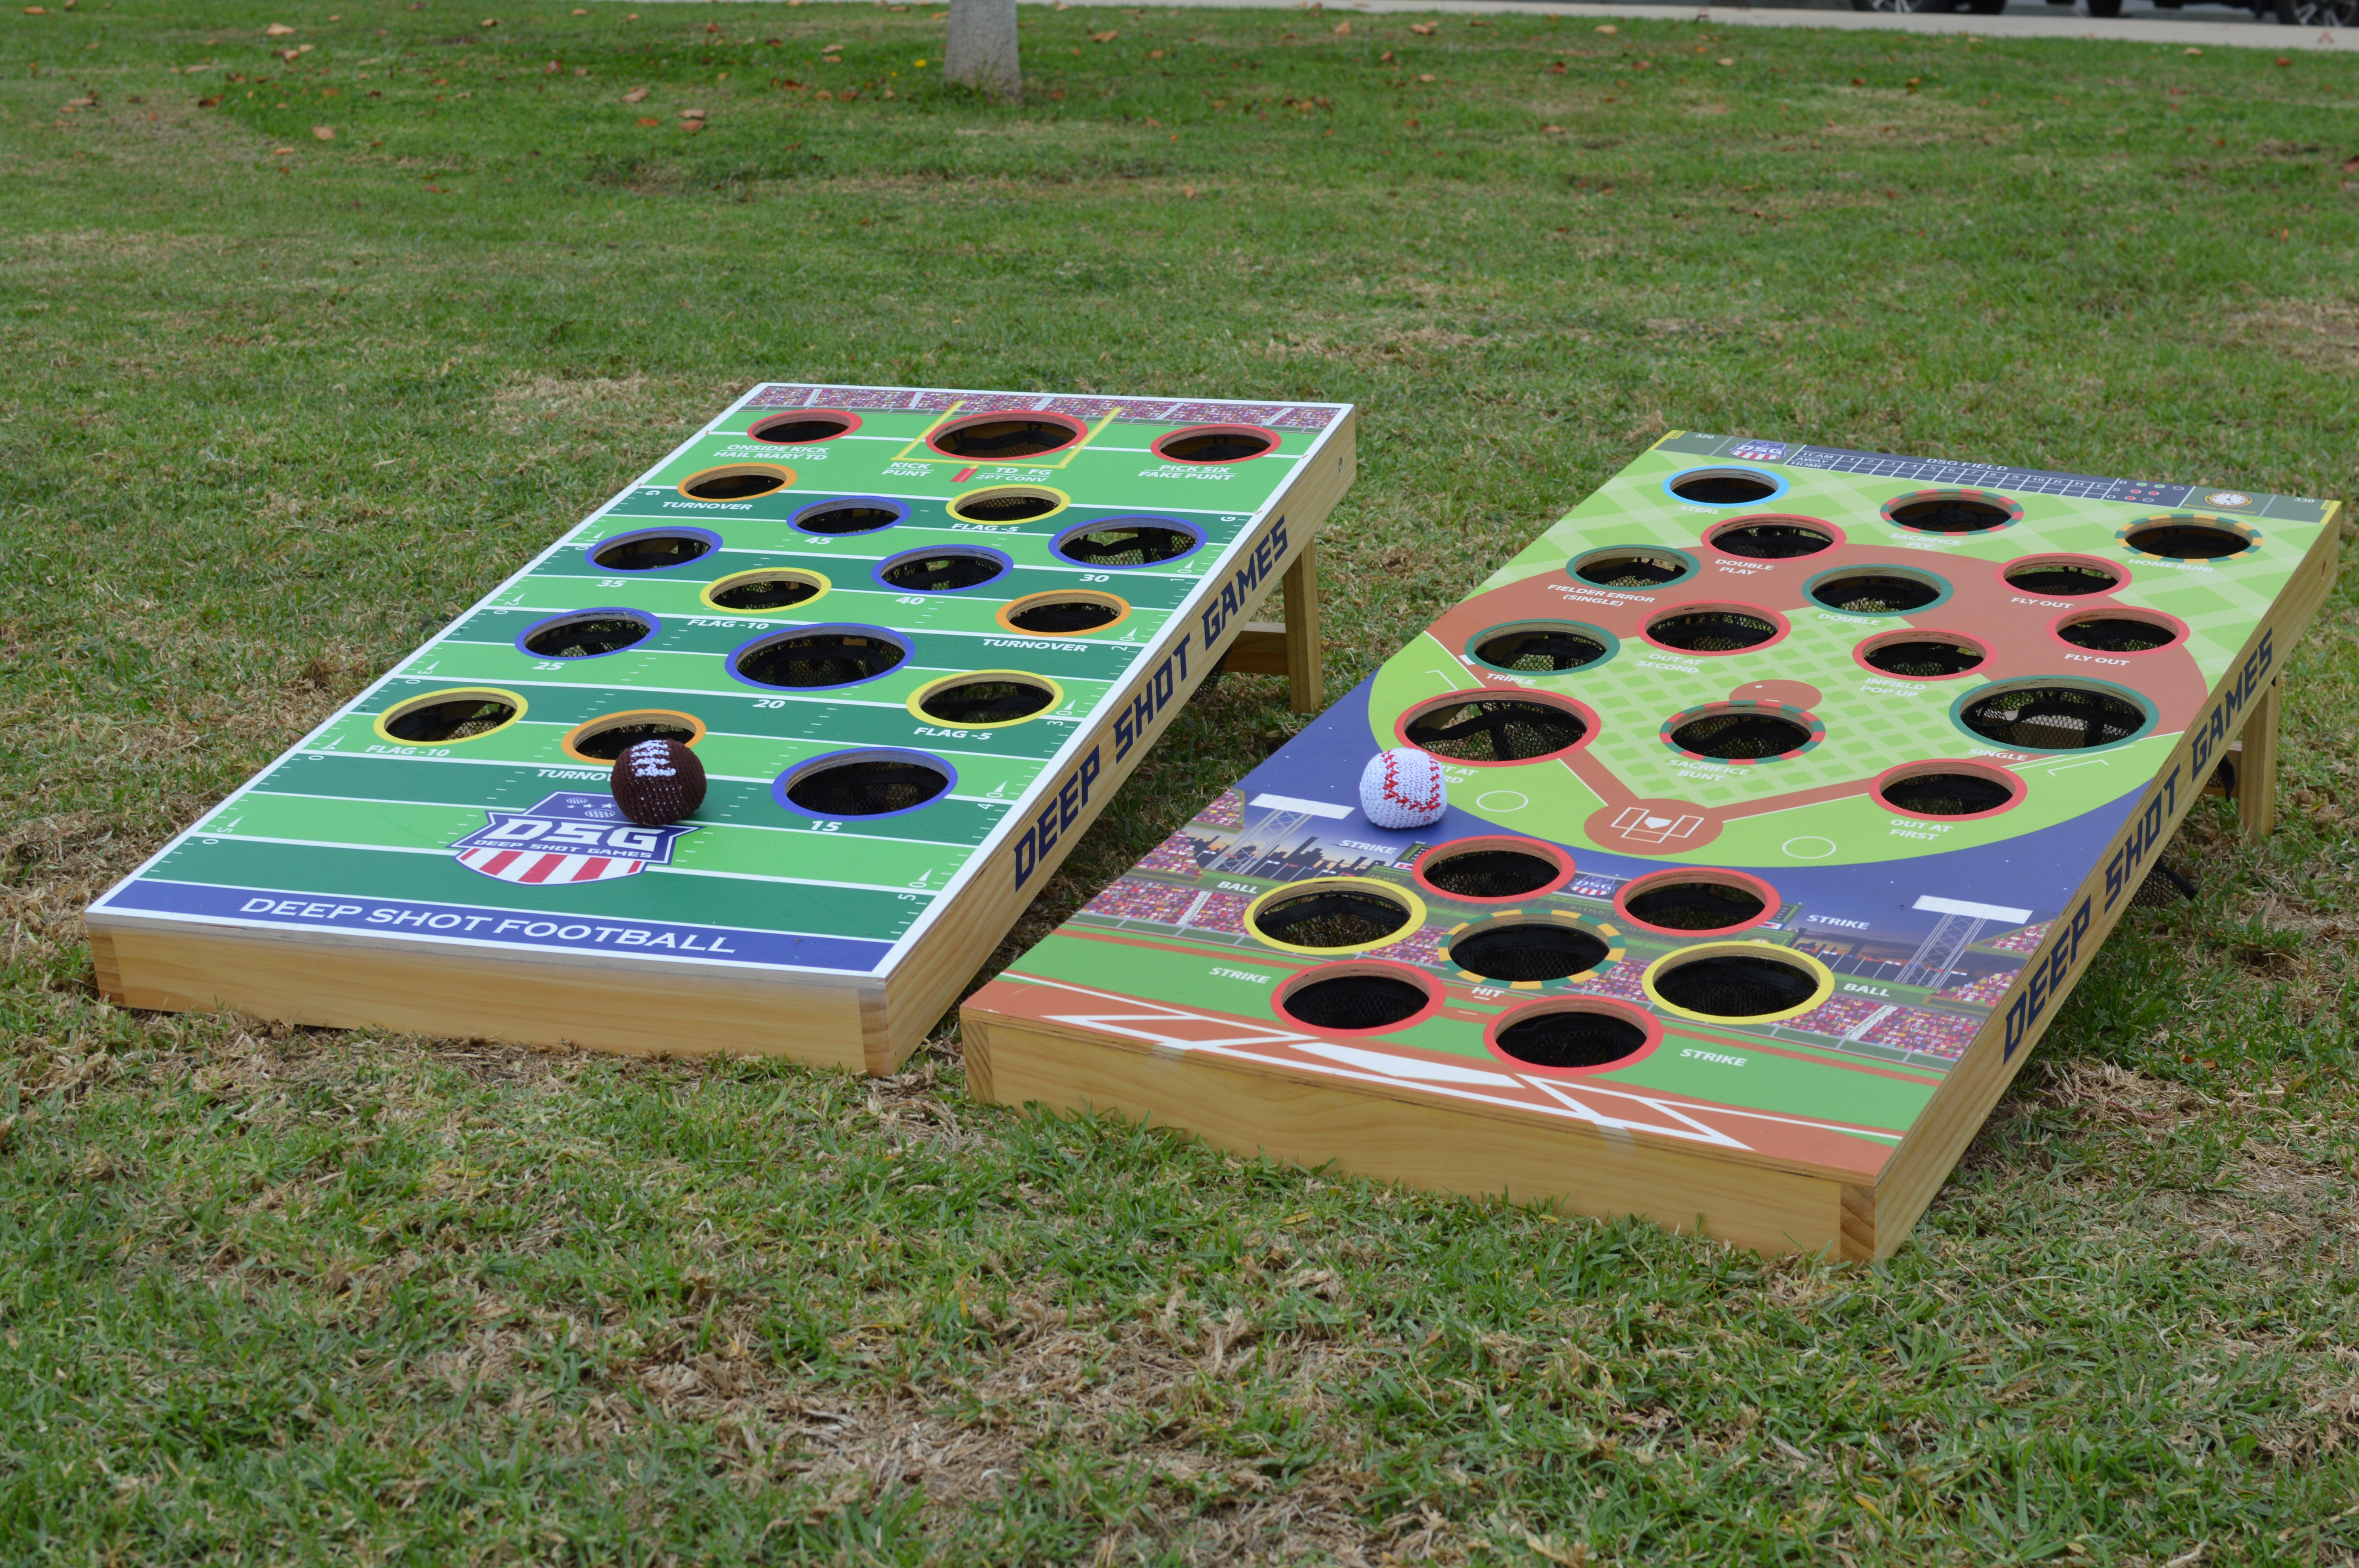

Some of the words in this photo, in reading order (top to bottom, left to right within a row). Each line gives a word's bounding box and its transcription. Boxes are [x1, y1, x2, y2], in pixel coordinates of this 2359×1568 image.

[1737, 445, 1783, 454] DSG
[1961, 462, 2008, 471] FIELD
[662, 501, 753, 510] TURNOVER
[1679, 505, 1719, 514] STEAL
[951, 523, 999, 532] FLAG
[1890, 534, 1963, 545] SACRIFICE
[1715, 559, 1775, 570] DOUBLE
[2128, 559, 2175, 568] HOME
[2176, 563, 2214, 573] RUN!
[1719, 567, 1757, 575] PLAY
[1079, 574, 1110, 583] 30
[1547, 584, 1606, 596] FIELDER
[1607, 592, 1655, 603] ERROR
[1563, 594, 1624, 607] (SINGLE)
[687, 619, 737, 628] FLAG
[1818, 613, 1881, 626] DOUBLE
[983, 639, 1088, 652] TURNOVER
[1649, 653, 1683, 662] OUT
[2095, 658, 2130, 666] OUT
[533, 662, 565, 670] 25
[1637, 661, 1699, 673] SECOND
[1487, 673, 1536, 685] TRIPLE
[1865, 678, 1926, 690] INFIELD
[752, 699, 785, 709] 20
[1014, 744, 1100, 893] DEEP
[1113, 633, 1190, 764] SHOT
[1201, 514, 1288, 651] GAMES
[914, 727, 968, 739] FLAG
[365, 745, 417, 755] FLAG
[1968, 748, 2028, 761] SINGLE
[1668, 759, 1750, 775] SACRIFICE
[537, 769, 612, 781] TURNO
[1677, 770, 1725, 781] BUNT
[811, 820, 842, 832] 15
[1890, 819, 1928, 829] OUT
[482, 818, 666, 852] DSG
[1890, 829, 1939, 840] FIRST
[1339, 840, 1398, 855] STRIKE
[2003, 893, 2092, 1066] DEEP
[2104, 764, 2180, 915] SHOT
[2192, 627, 2273, 782] GAMES
[587, 848, 652, 858] GAMES
[1217, 881, 1258, 894] BALL
[239, 898, 362, 919] DEEP
[365, 908, 494, 931] SHOT
[493, 918, 736, 954] FOOTBALL
[1807, 915, 1870, 930] STRIKE
[1209, 967, 1271, 984] STRIKE
[1471, 987, 1505, 998] HIT
[1843, 983, 1890, 997] BALL
[1679, 1049, 1748, 1067] STRIKE
